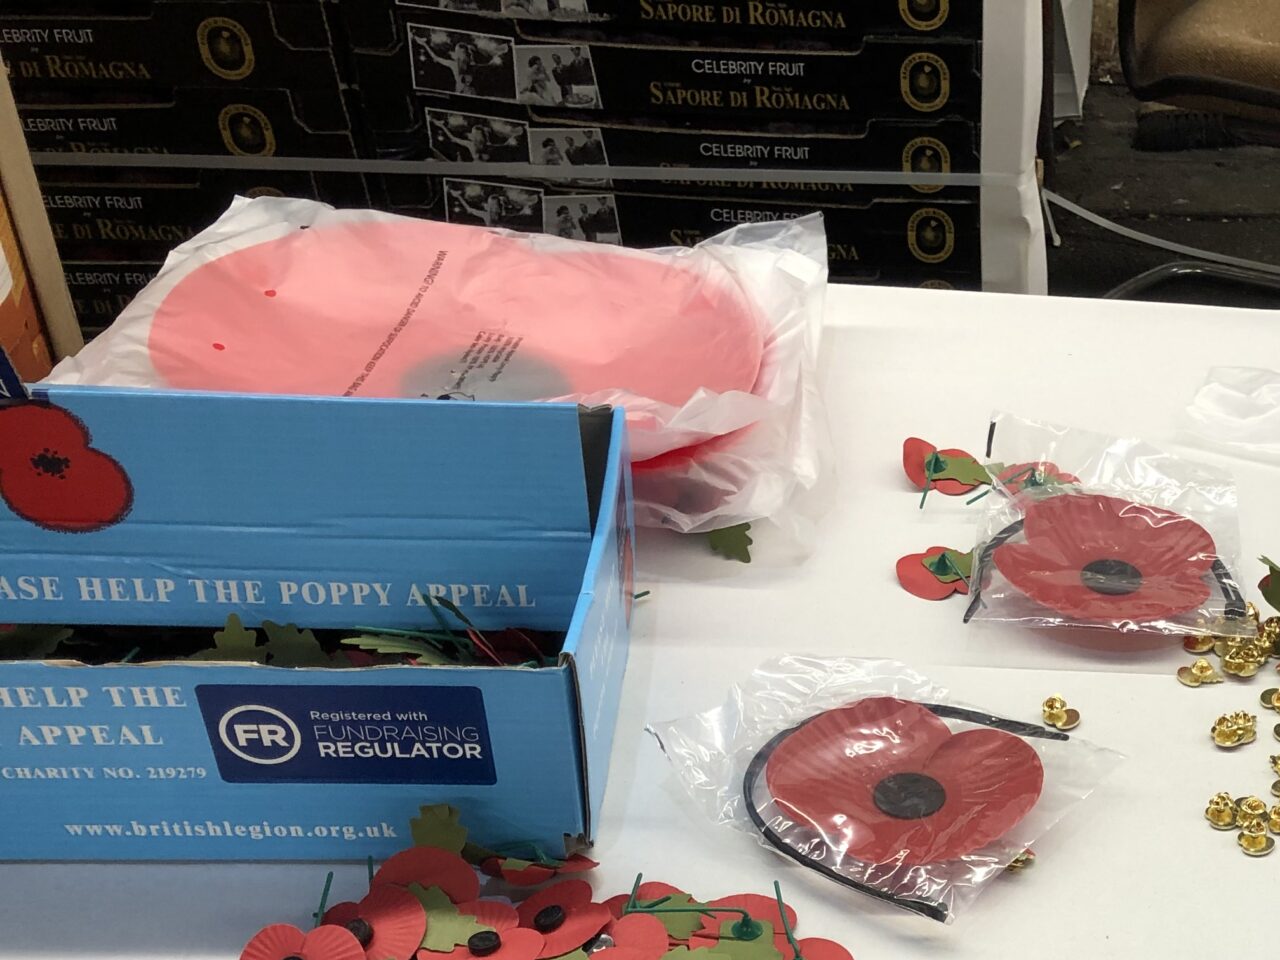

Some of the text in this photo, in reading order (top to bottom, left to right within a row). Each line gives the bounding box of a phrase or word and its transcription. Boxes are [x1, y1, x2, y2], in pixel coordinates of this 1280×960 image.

[640, 0, 847, 28] SAPORE DI ROMAGNA
[53, 28, 94, 44] FRUIT
[44, 54, 152, 79] ROMAGNA
[691, 59, 805, 76] CELEBRITY FRUIT
[649, 81, 851, 110] SAPORE DI ROMAGNA
[78, 117, 118, 132] FRUIT
[700, 143, 810, 160] CELEBRITY FRUIT
[42, 195, 144, 209] ELEBRITY FRUIT
[0, 576, 536, 609] ASE HELP THE POPPY APPEAL
[102, 686, 188, 709] THE
[310, 709, 428, 725] Registered with
[17, 725, 165, 747] APPEAL
[233, 724, 290, 748] FR
[314, 724, 480, 743] FUNDRAISING
[319, 742, 483, 760] REGULATOR
[2, 766, 207, 780] CHARITY NO. 219279
[64, 820, 398, 842] www.britishlegion.org.uk
